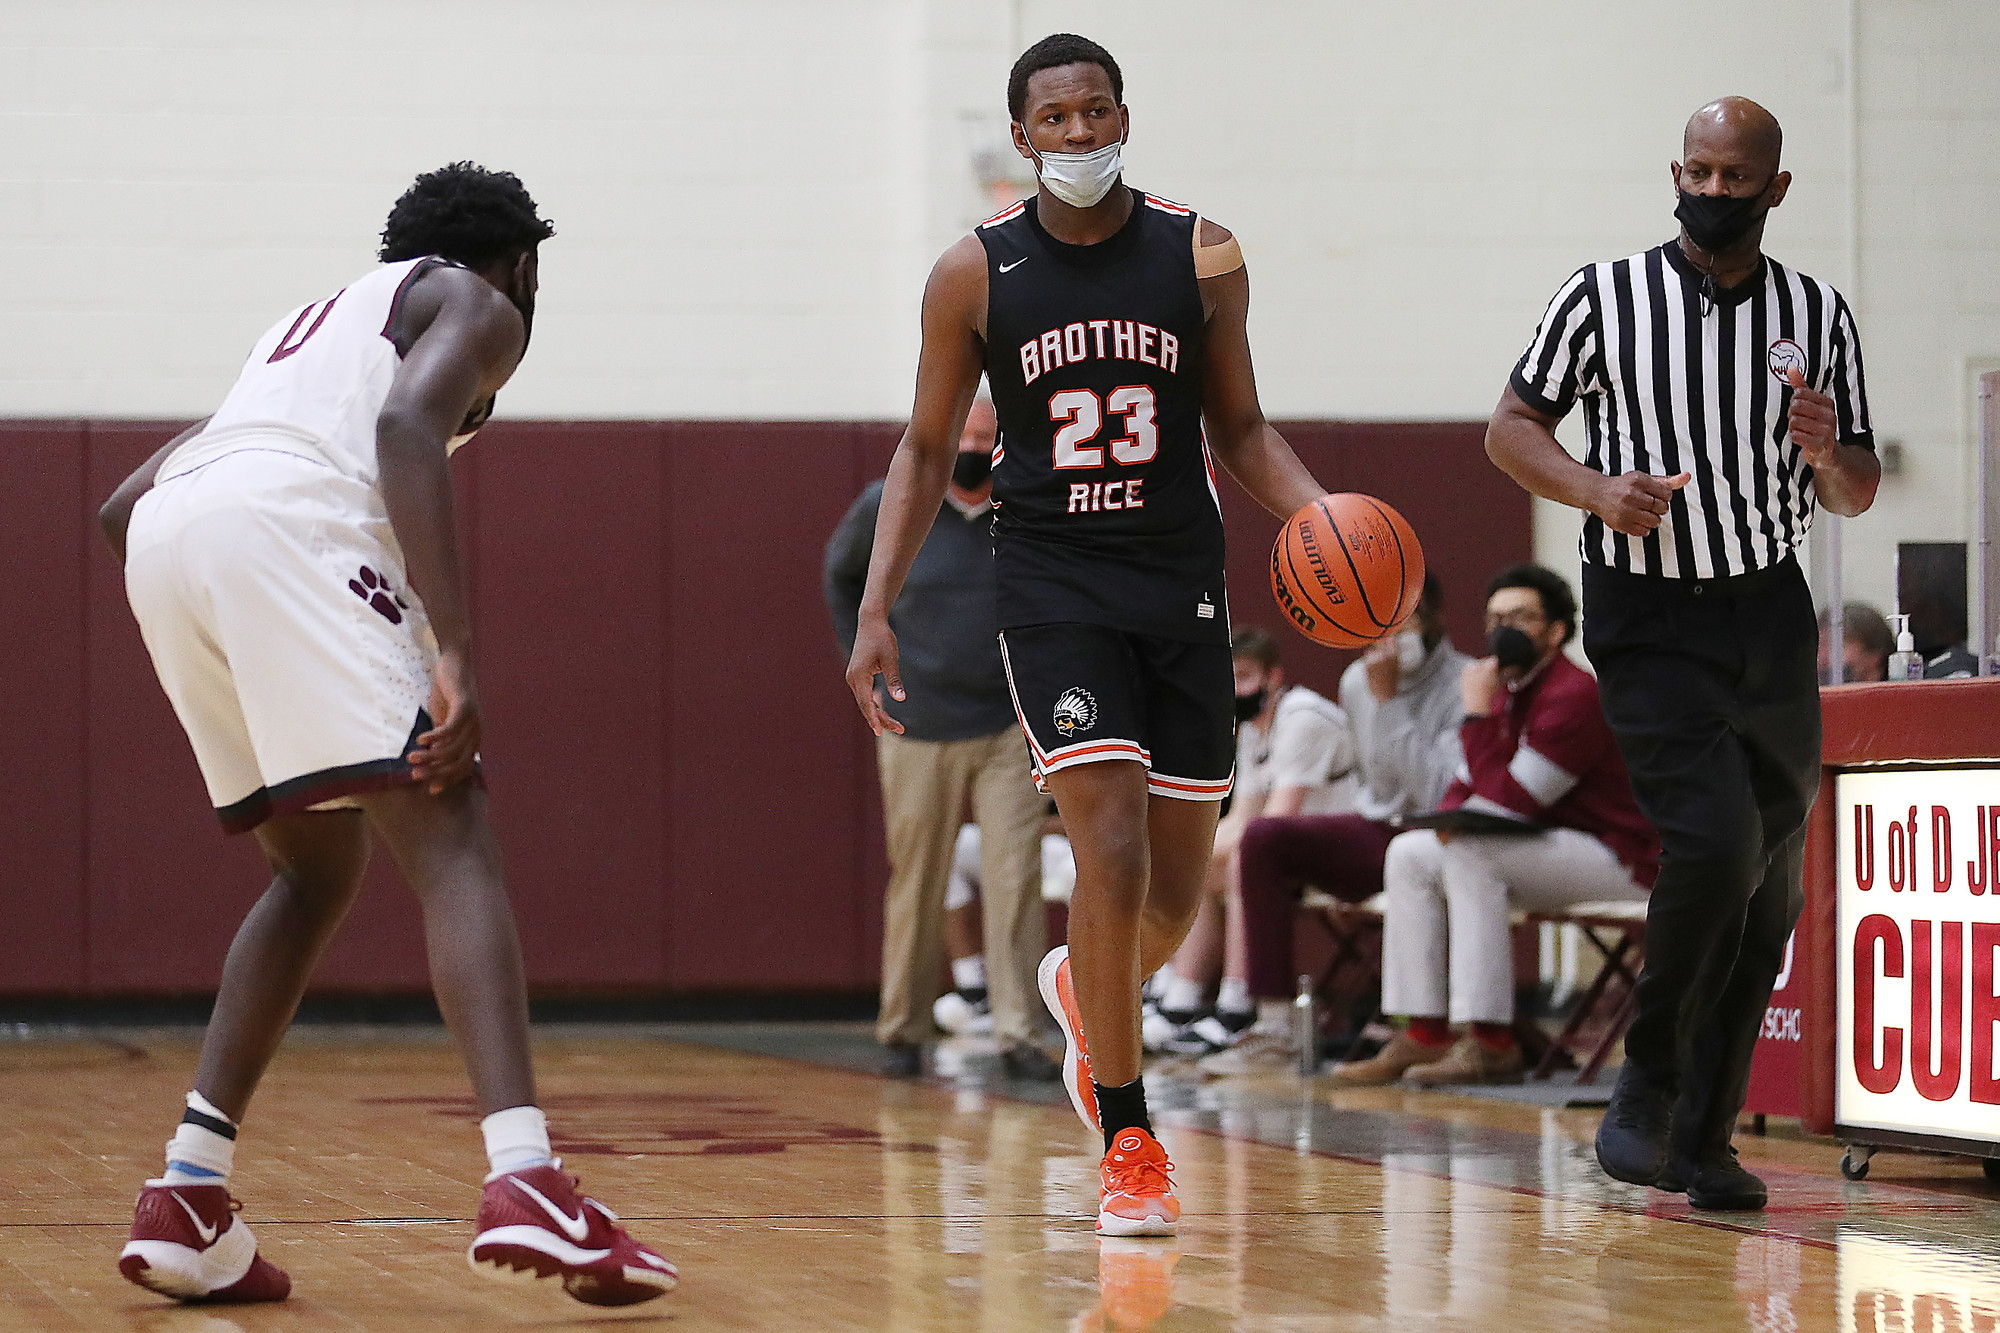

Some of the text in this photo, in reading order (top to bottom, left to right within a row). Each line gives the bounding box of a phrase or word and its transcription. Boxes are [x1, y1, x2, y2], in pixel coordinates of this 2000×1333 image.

[1019, 319, 1179, 386] BROTHER
[1048, 384, 1159, 470] 23
[1067, 478, 1145, 513] RICE
[1299, 520, 1345, 605] EVOLUTION
[1854, 804, 1875, 891] U
[1888, 805, 1918, 893] of
[1931, 805, 1952, 893] D
